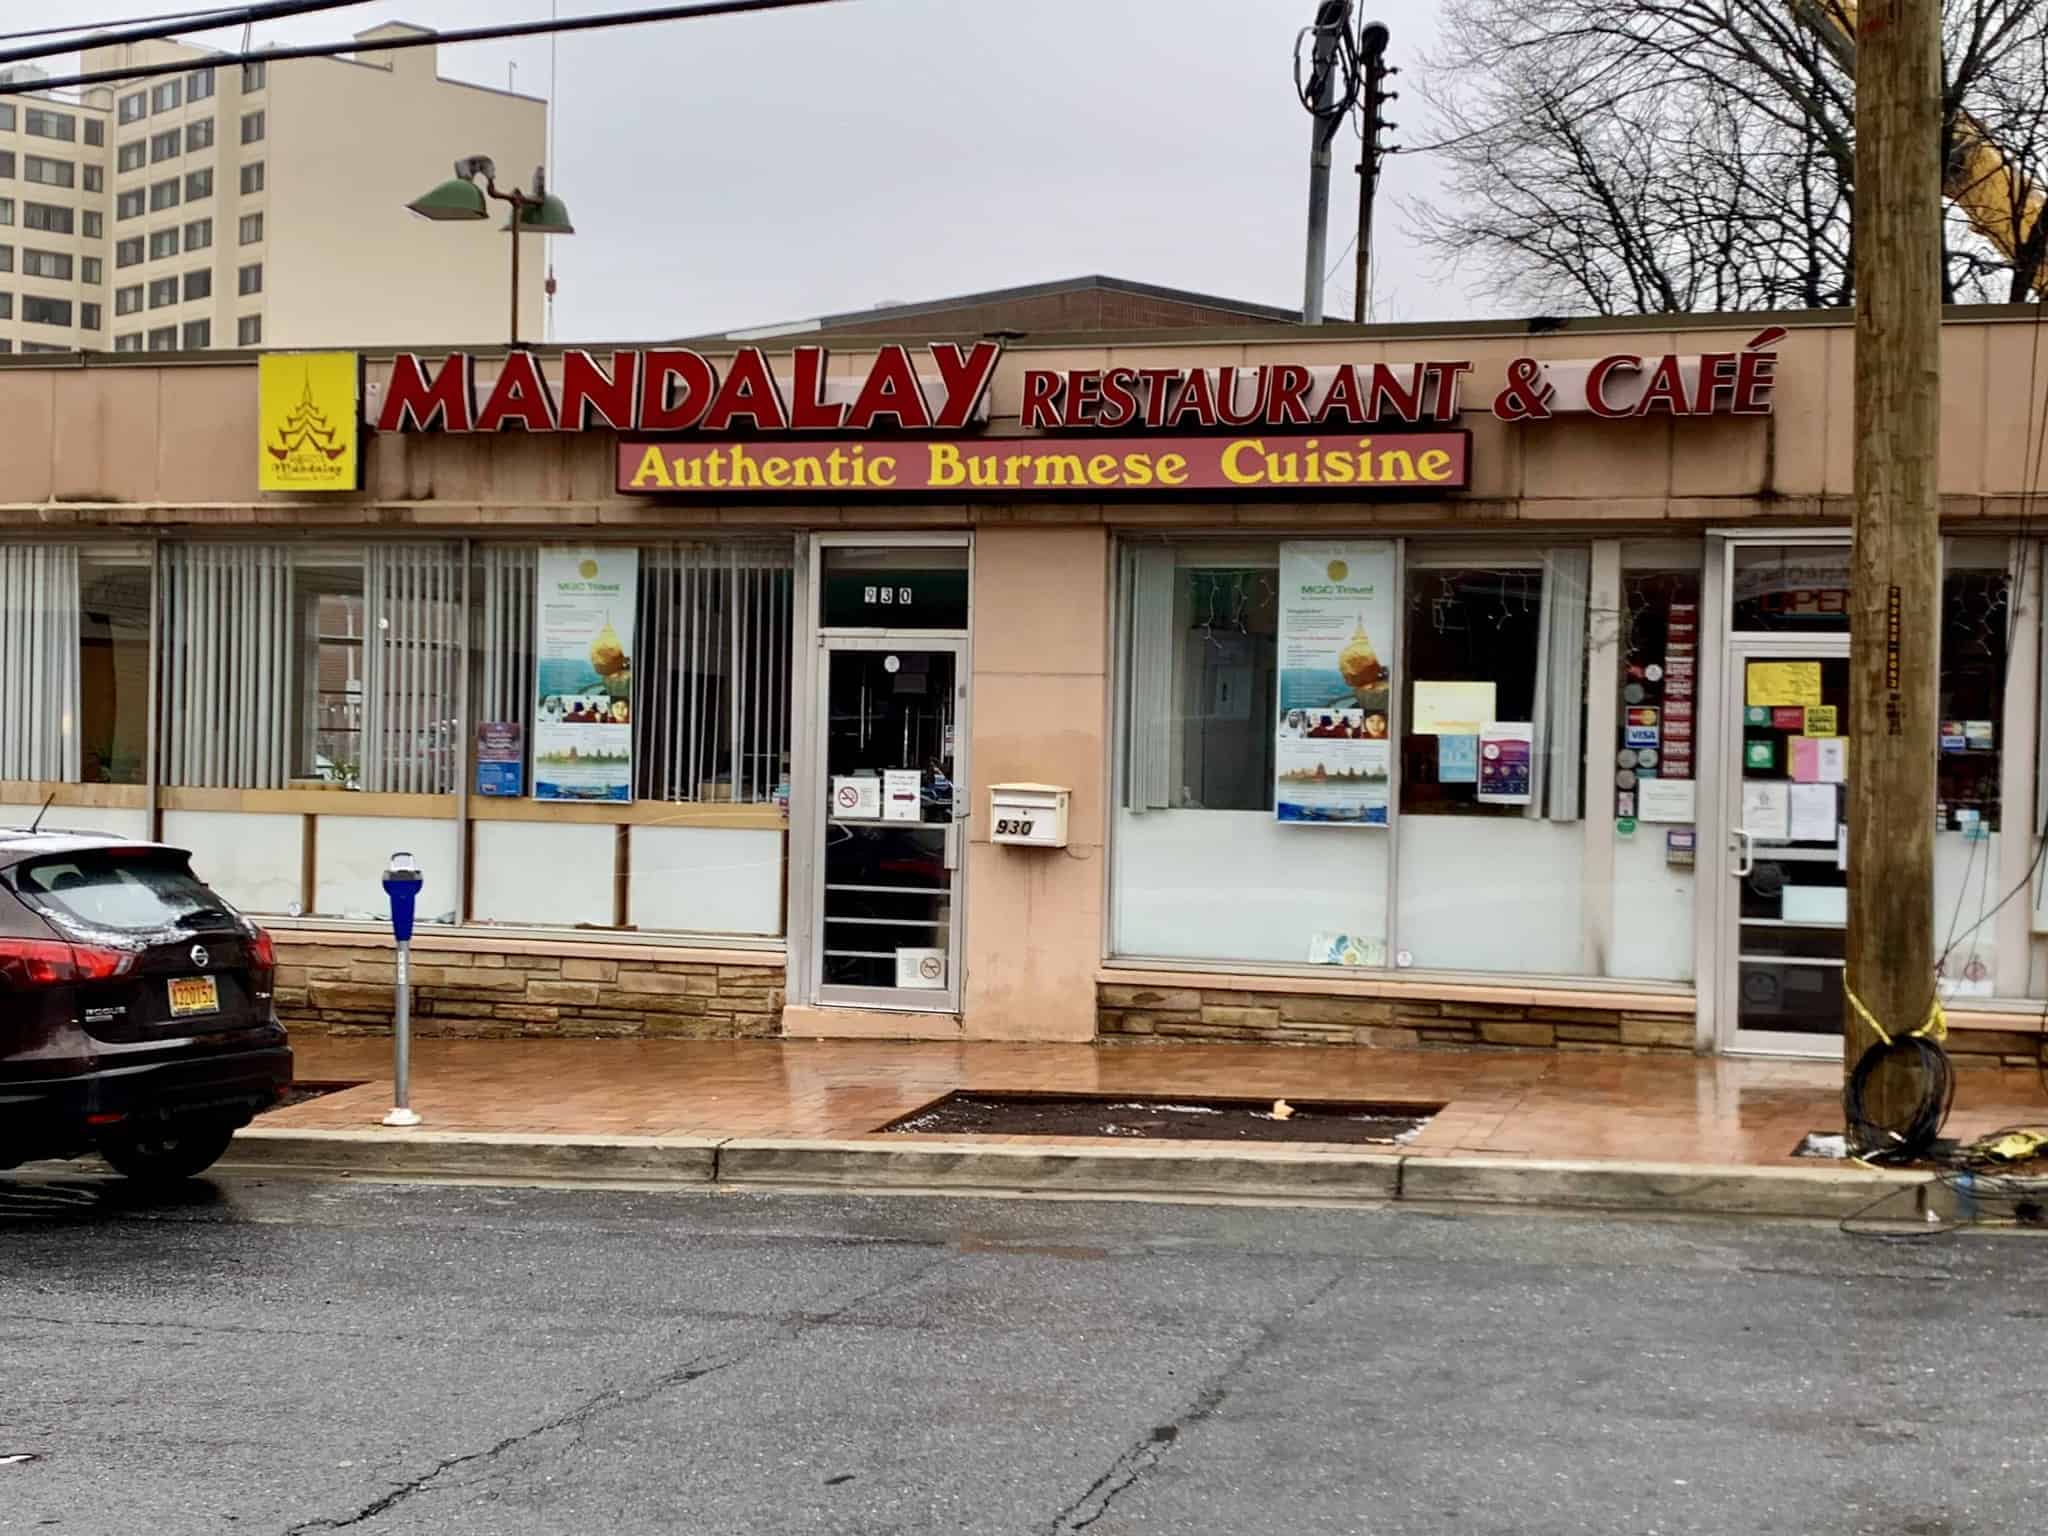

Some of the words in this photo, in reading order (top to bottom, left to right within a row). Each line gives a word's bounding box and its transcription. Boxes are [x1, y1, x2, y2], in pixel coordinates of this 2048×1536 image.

[377, 340, 1001, 433] MANDALAY
[1019, 359, 1473, 431] RESTAURANT
[1490, 356, 1555, 421] &
[1583, 326, 1788, 418] CAFÉ
[629, 442, 898, 491] Authentic
[925, 442, 1190, 491] Burmese
[1219, 438, 1456, 487] Cuisine
[864, 586, 912, 605] 930
[1631, 730, 1656, 739] VISA
[995, 819, 1034, 836] 930
